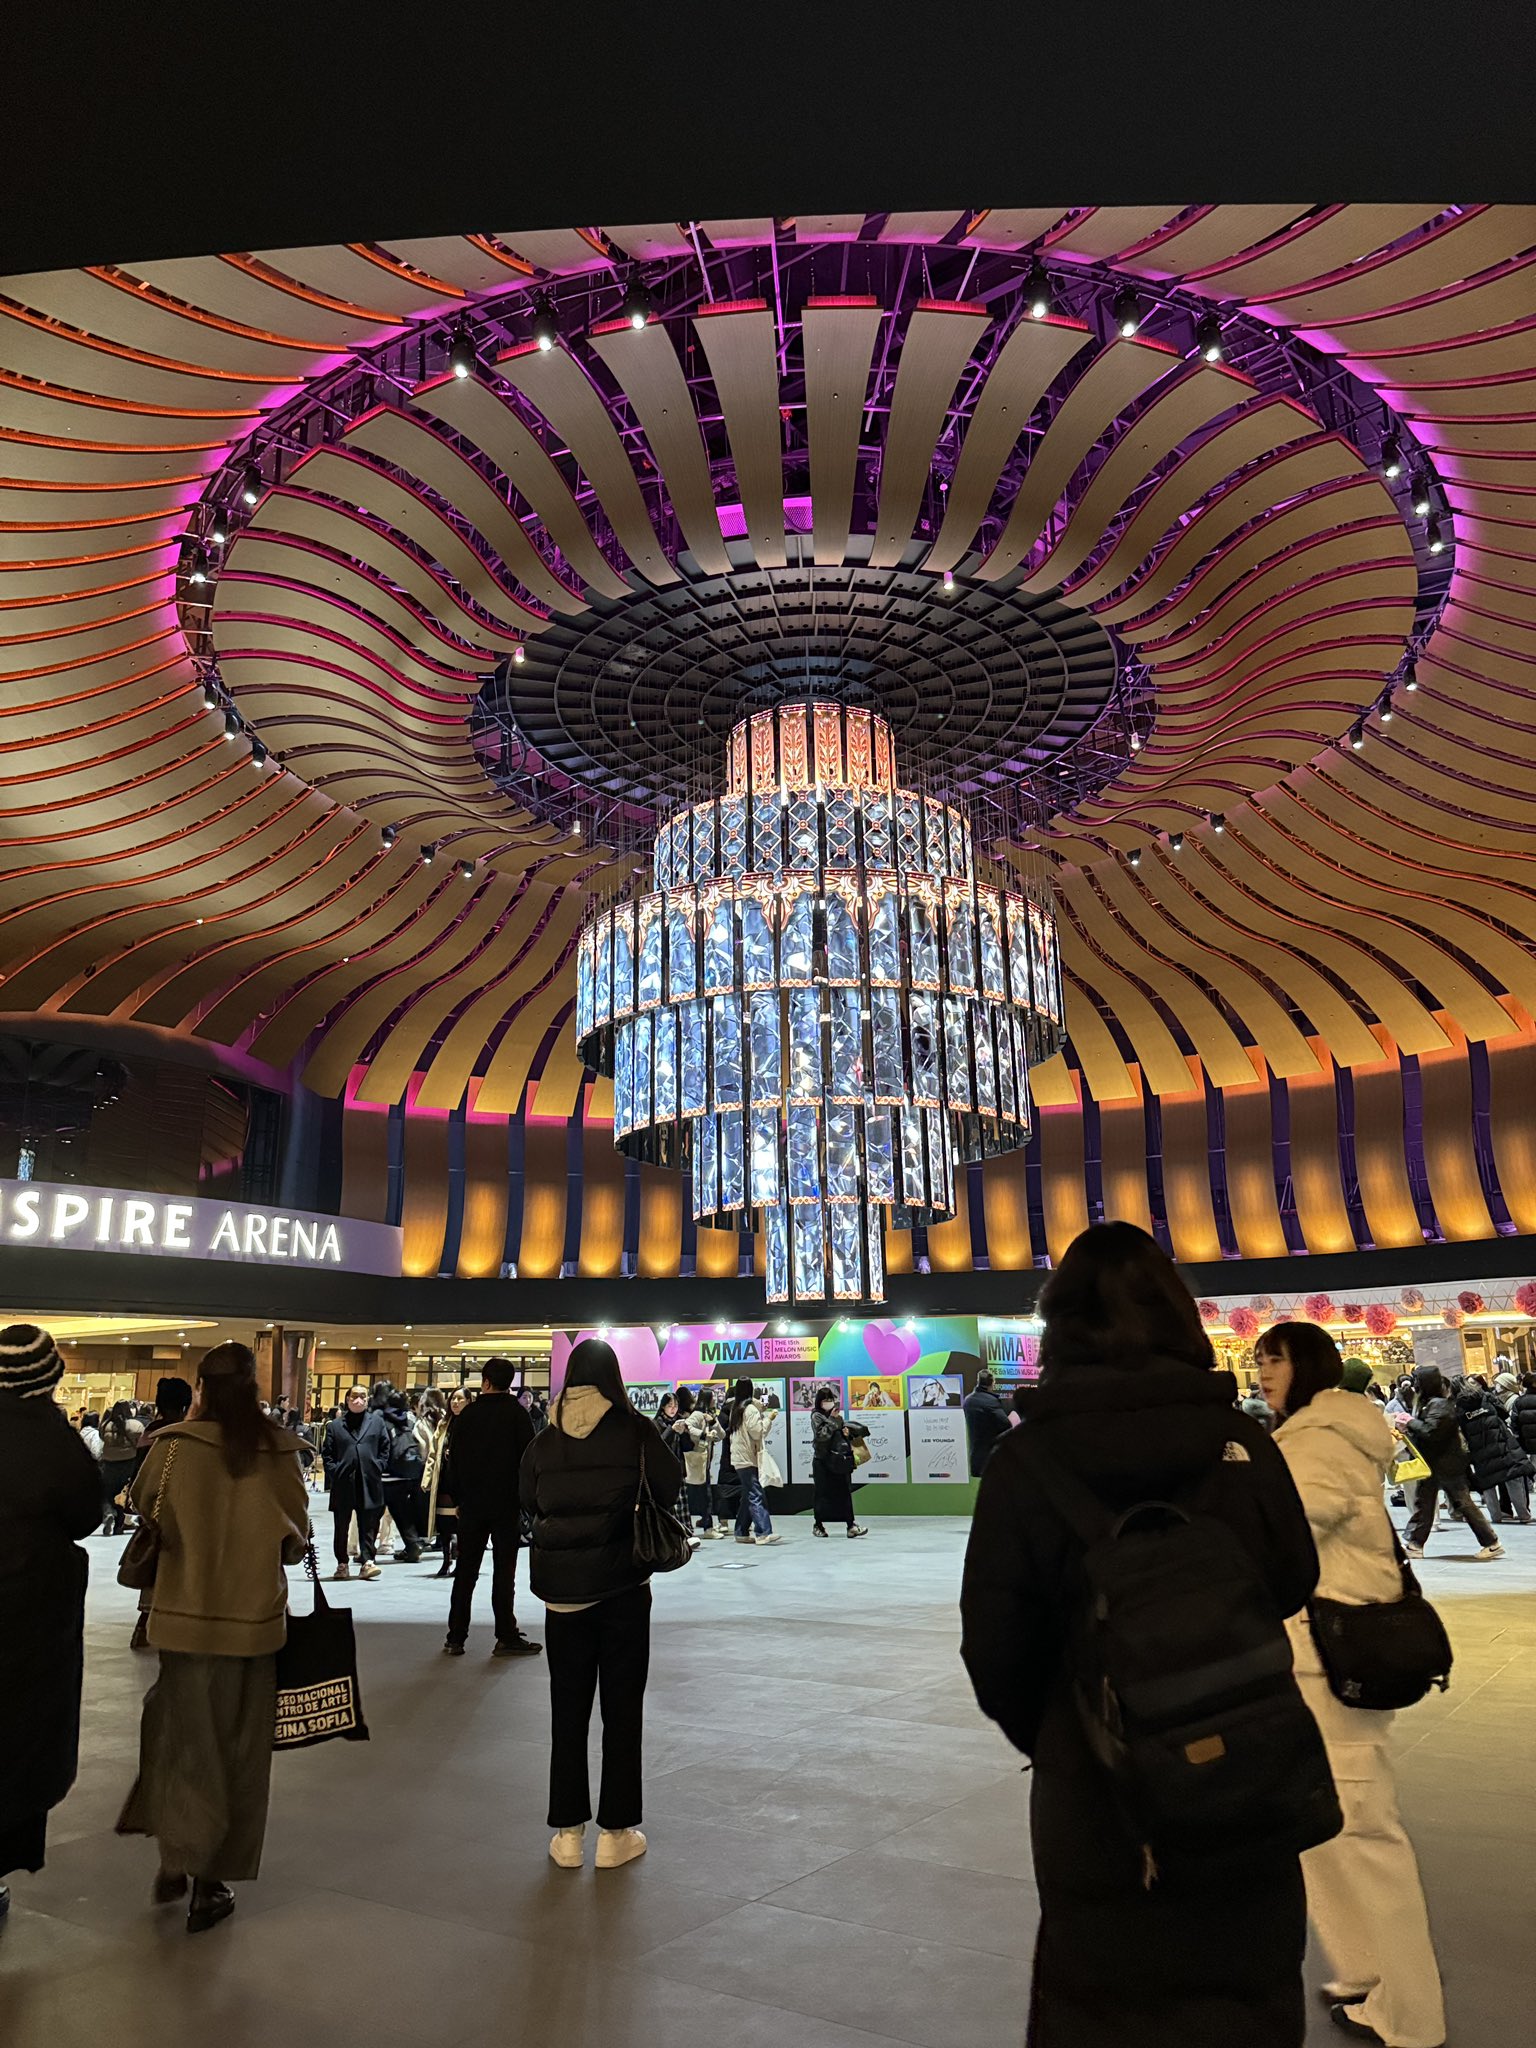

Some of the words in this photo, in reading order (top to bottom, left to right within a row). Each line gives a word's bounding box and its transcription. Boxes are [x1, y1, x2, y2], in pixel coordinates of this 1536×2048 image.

[0, 1190, 194, 1249] SPIRE
[210, 1210, 342, 1263] ARENA
[701, 1341, 760, 1361] MMA
[987, 1336, 1026, 1362] MMA
[296, 1683, 348, 1703] NACIONAL
[304, 1701, 319, 1713] DE
[321, 1693, 348, 1709] ARTE
[307, 1711, 350, 1732] SOFIA
